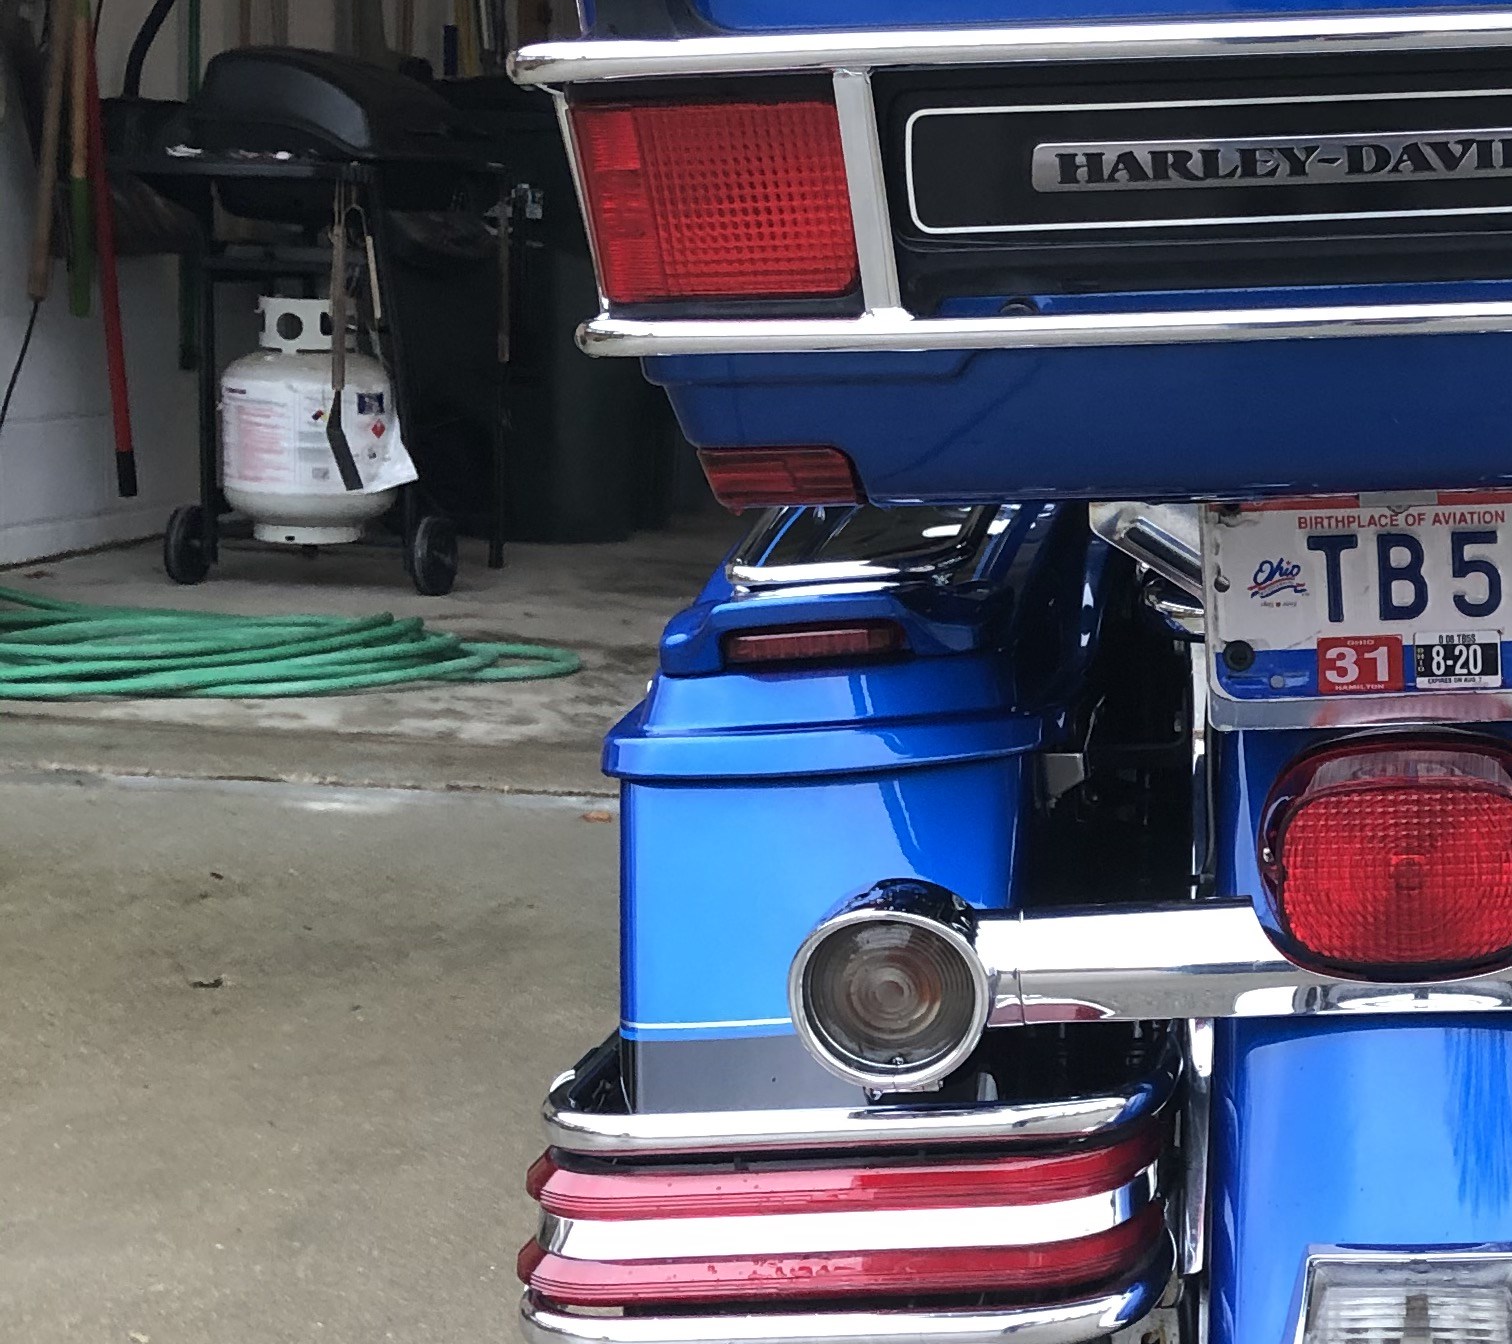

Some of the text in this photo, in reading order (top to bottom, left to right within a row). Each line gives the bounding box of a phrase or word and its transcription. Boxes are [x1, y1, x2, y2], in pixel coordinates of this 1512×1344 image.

[1297, 510, 1506, 530] BIRTHPLACE OF AVIATION
[1252, 557, 1302, 585] Ohio
[1325, 646, 1389, 684] 31
[1431, 644, 1482, 676] 8-20
[1334, 683, 1385, 692] HAMILTON
